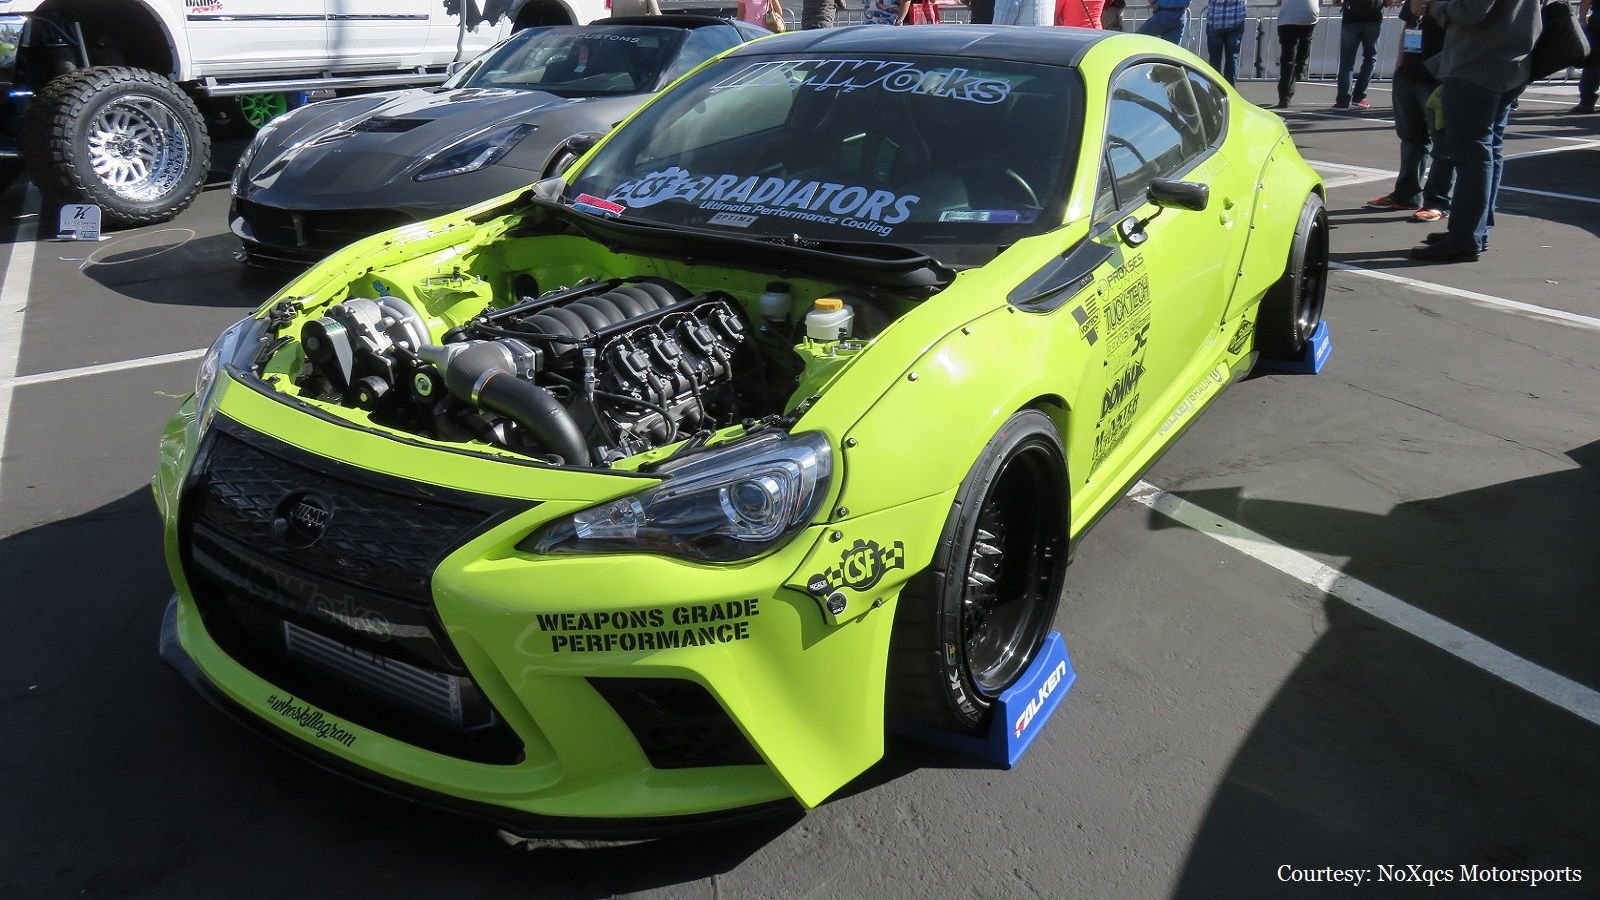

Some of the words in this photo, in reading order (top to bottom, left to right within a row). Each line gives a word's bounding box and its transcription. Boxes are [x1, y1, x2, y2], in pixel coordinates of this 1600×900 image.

[700, 174, 920, 224] RADIATORS
[699, 200, 752, 213] Ultimate
[752, 205, 836, 224] Performance
[841, 217, 893, 237] Cooling
[843, 548, 875, 584] CSF
[536, 608, 664, 632] WEAPONS
[672, 598, 759, 625] GRADE
[551, 621, 749, 652] PERFORMANCE
[1014, 659, 1066, 739] FALKEN
